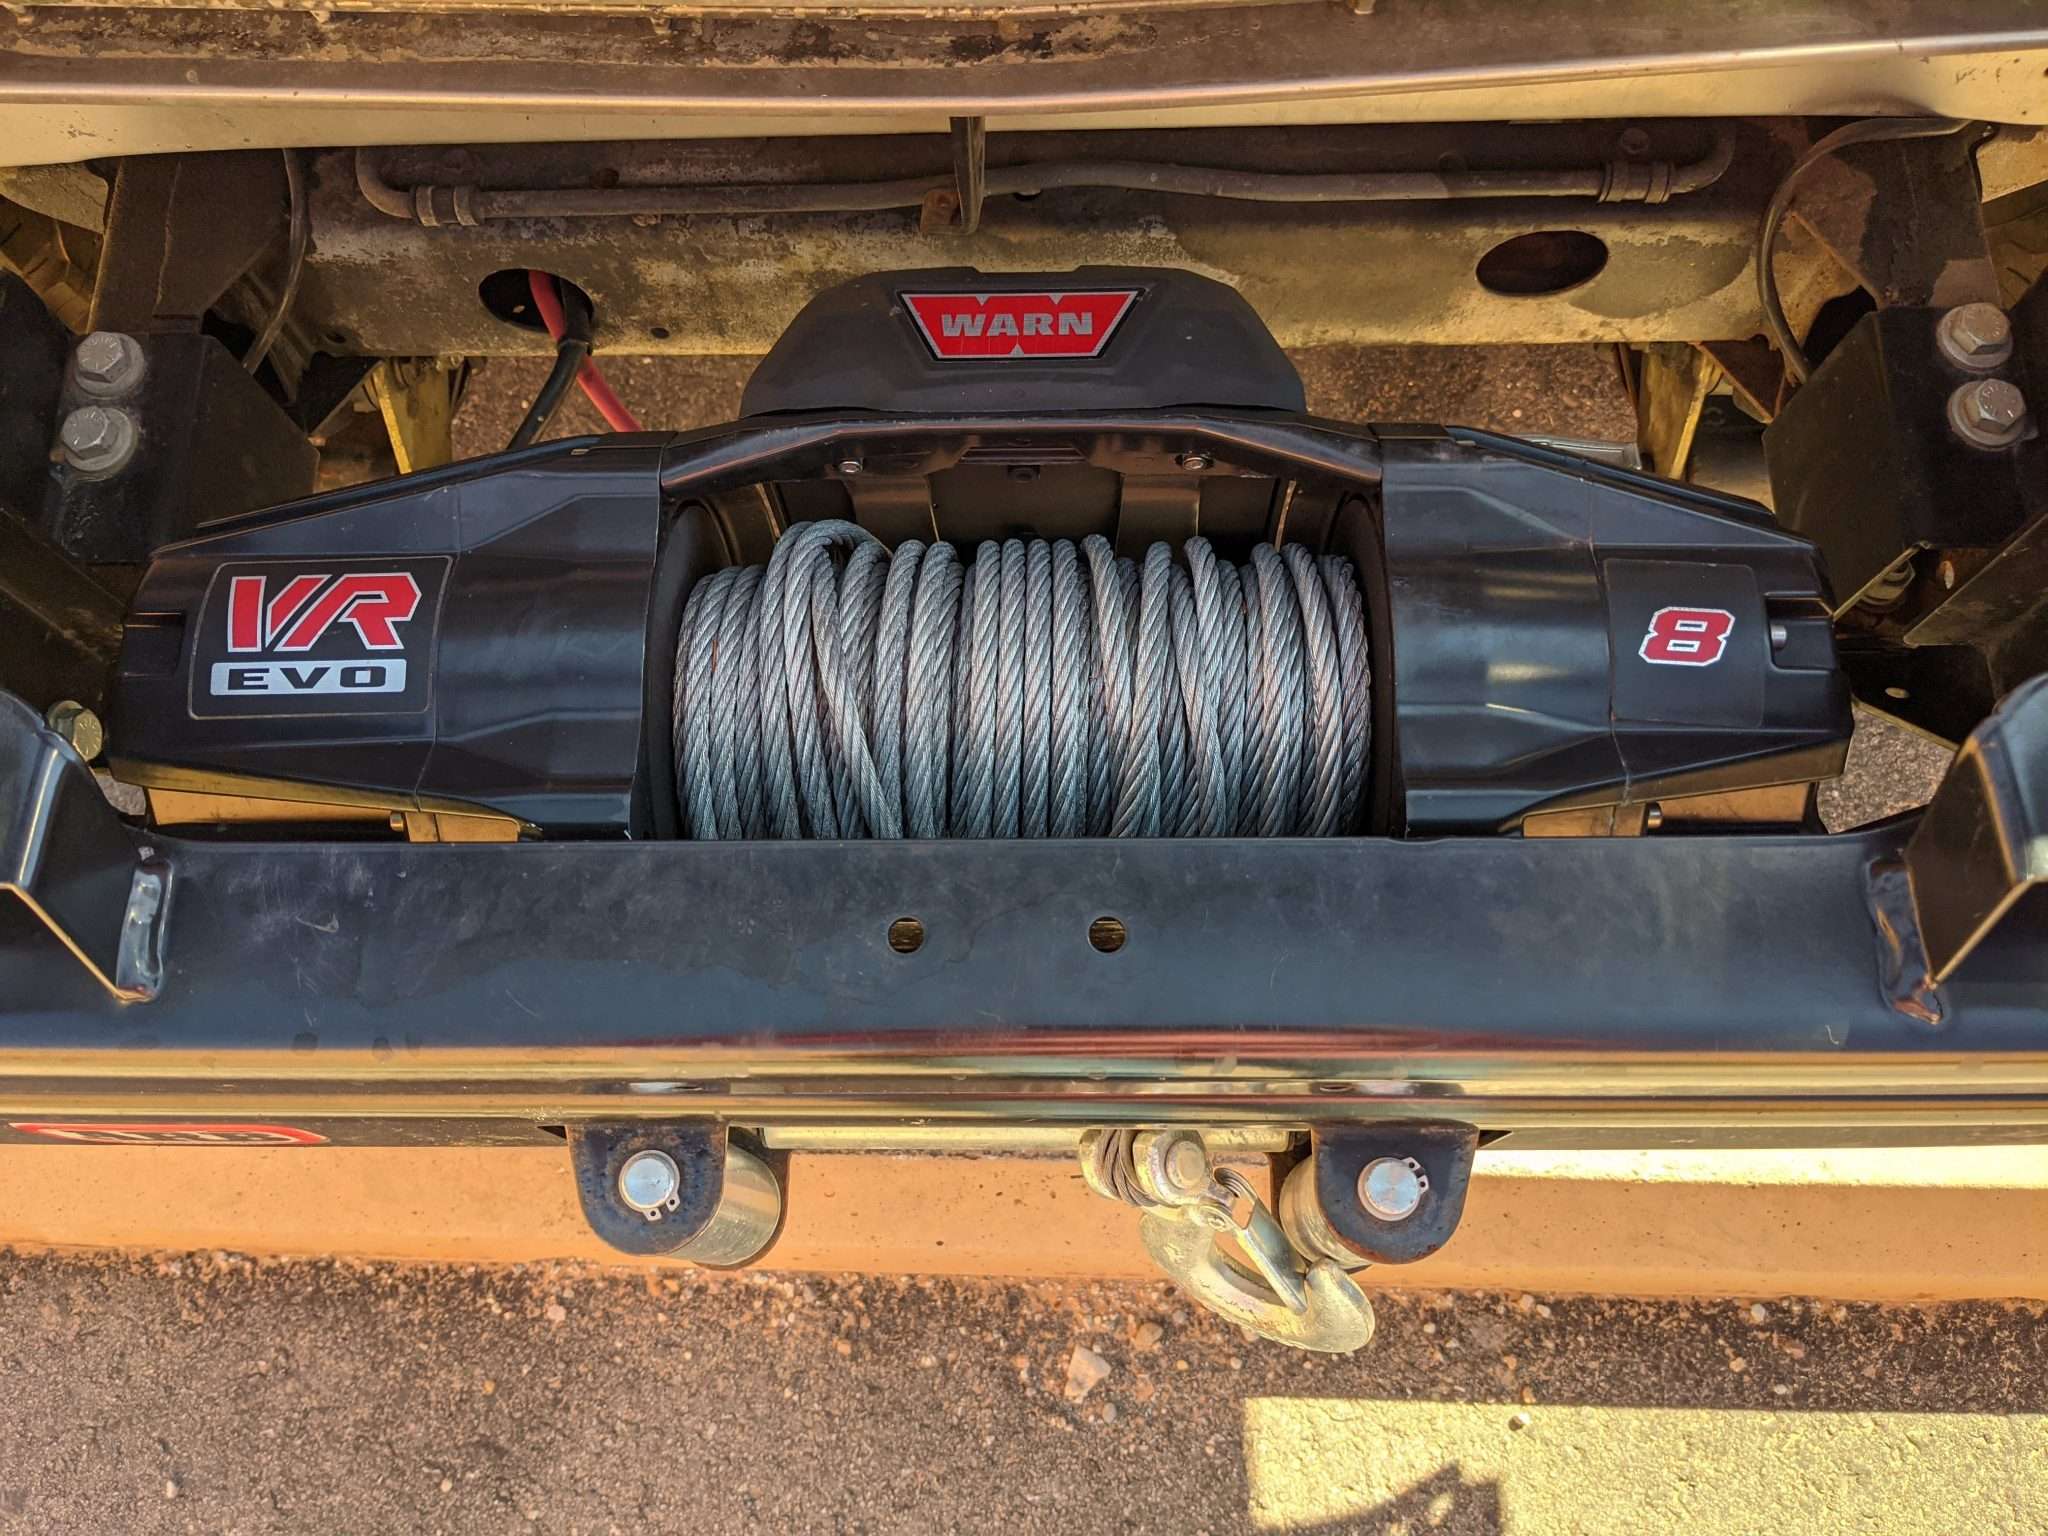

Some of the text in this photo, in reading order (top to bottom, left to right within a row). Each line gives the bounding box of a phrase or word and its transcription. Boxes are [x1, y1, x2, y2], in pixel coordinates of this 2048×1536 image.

[941, 312, 1093, 337] WARN
[227, 572, 422, 653] VR
[1638, 606, 1736, 667] 8
[227, 666, 387, 691] EVO
